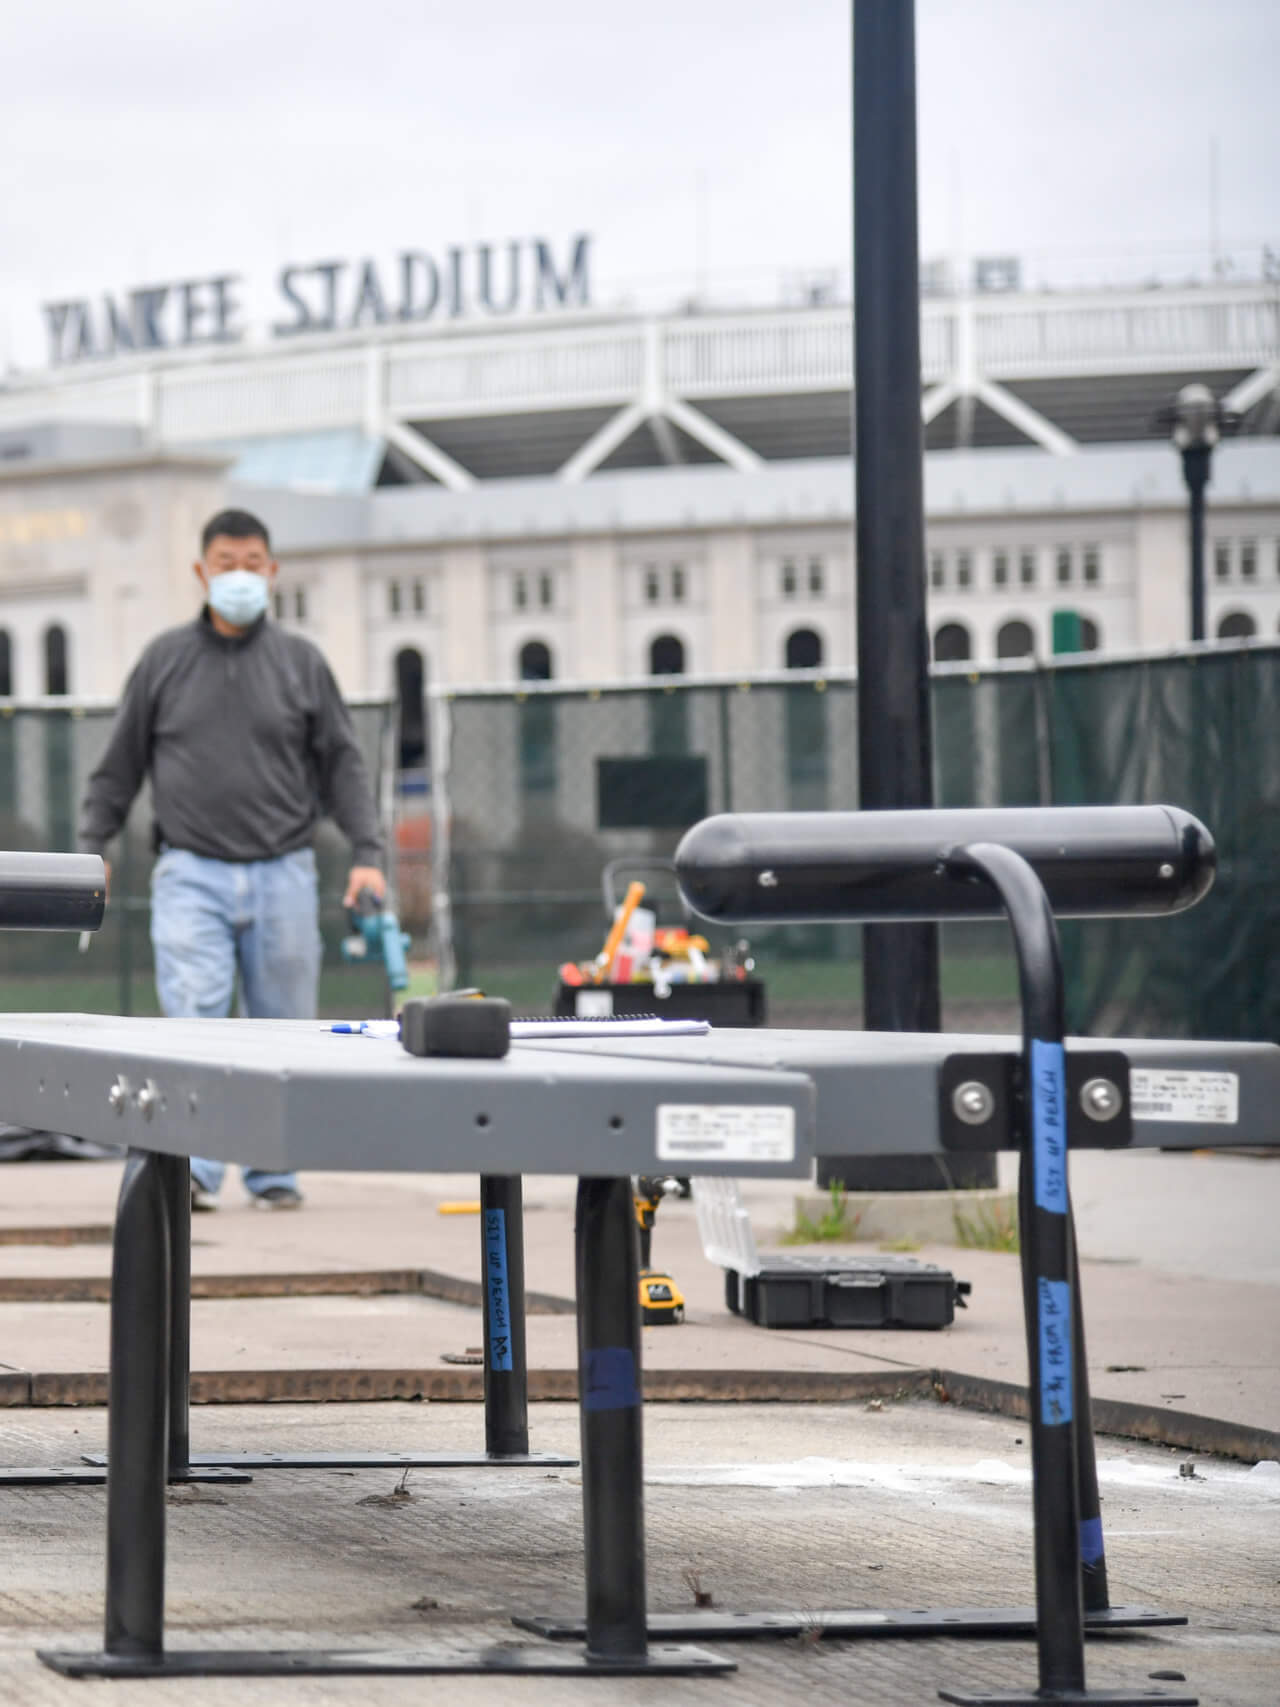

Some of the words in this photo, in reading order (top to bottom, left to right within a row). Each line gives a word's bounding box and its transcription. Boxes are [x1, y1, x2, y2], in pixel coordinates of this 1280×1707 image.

[41, 270, 246, 366] YANKEE
[271, 231, 592, 338] STADIUM
[491, 1276, 508, 1329] BENCH
